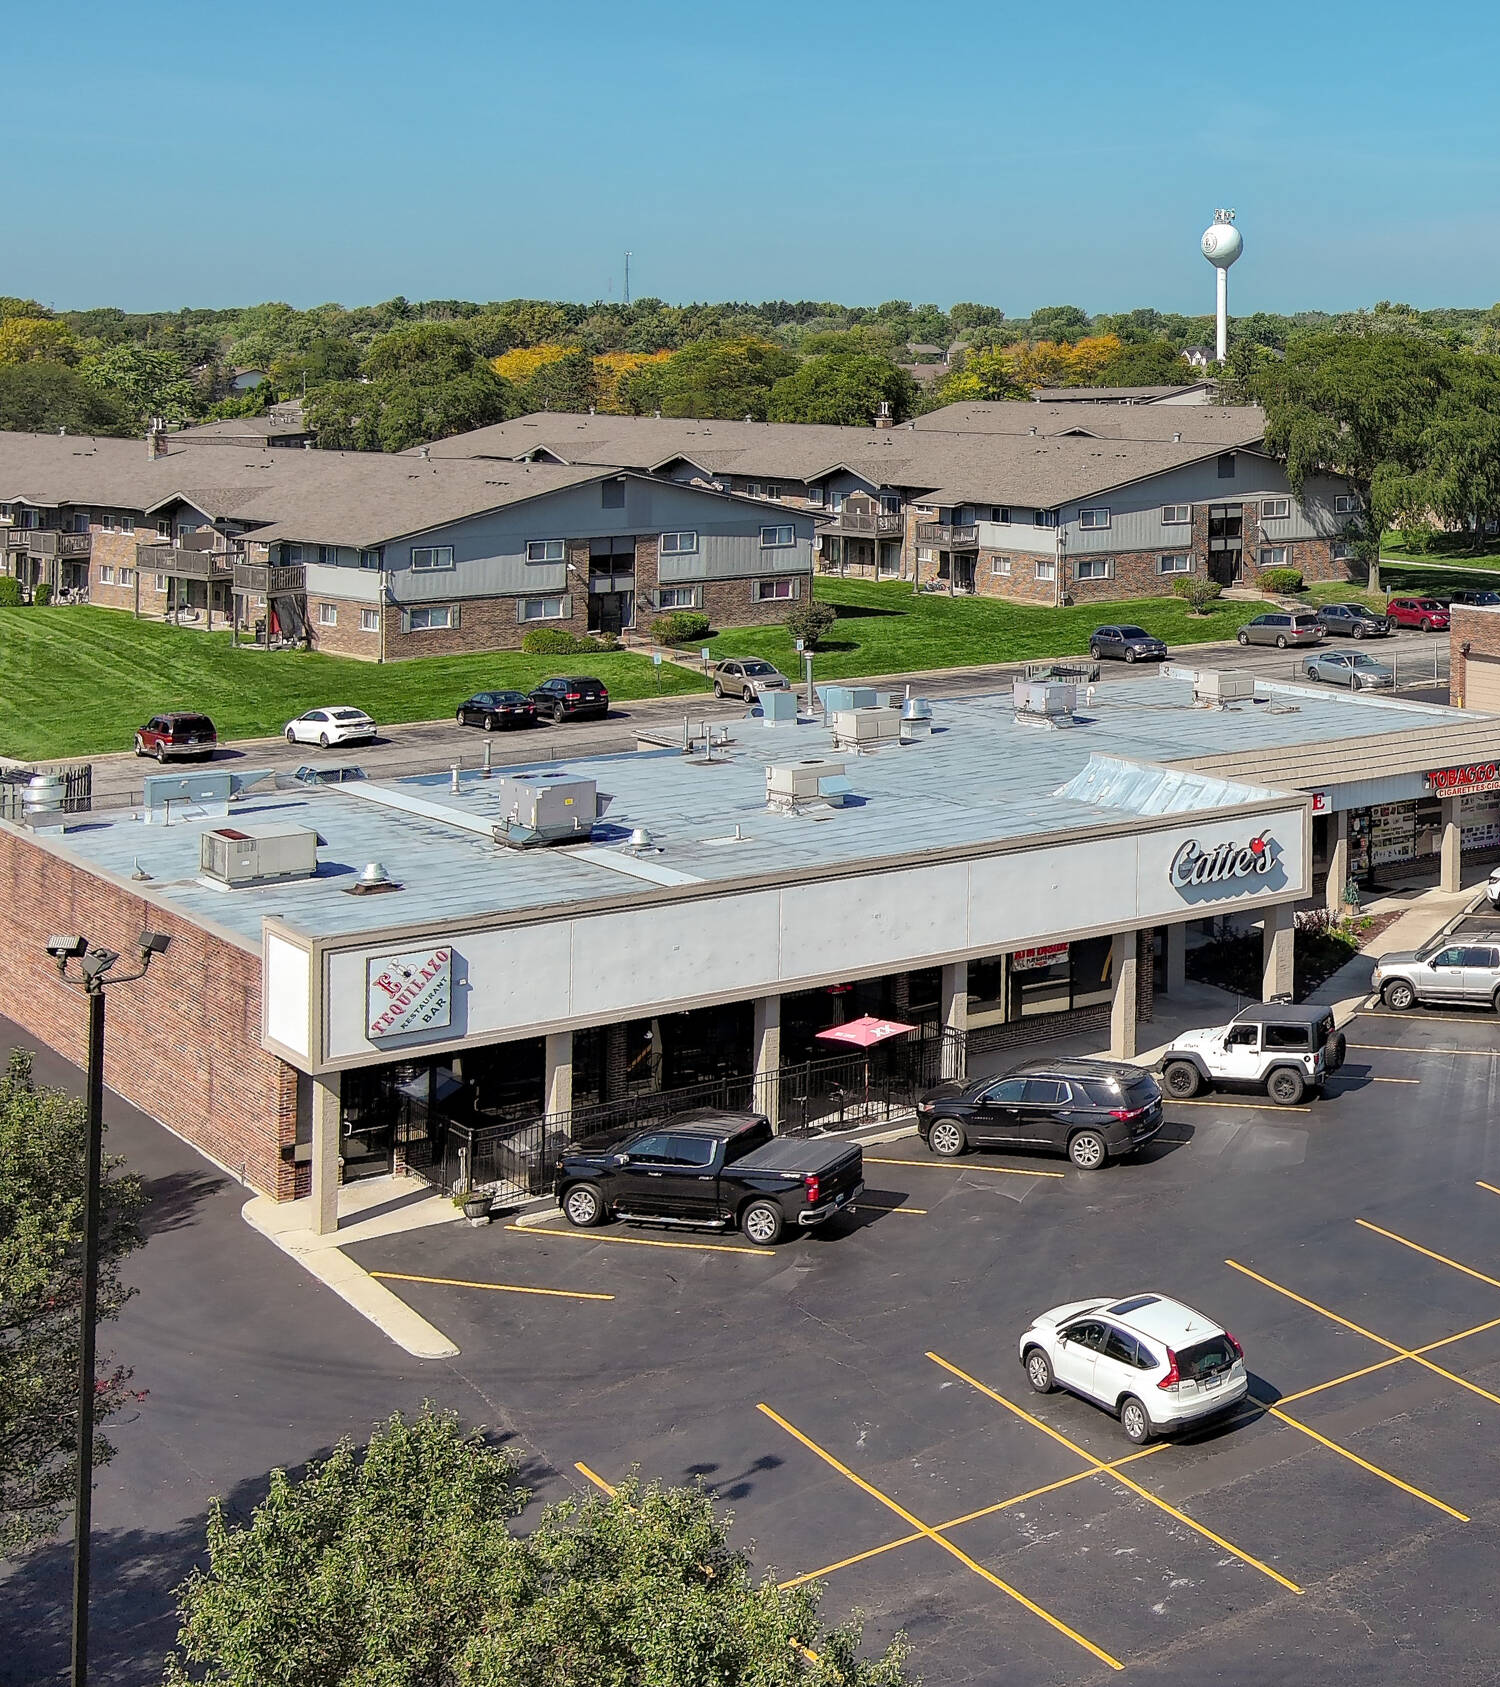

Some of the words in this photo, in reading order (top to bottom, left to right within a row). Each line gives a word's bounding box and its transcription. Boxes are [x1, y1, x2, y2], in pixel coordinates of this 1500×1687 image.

[1427, 763, 1496, 789] TOBACCO
[371, 950, 449, 1035] TEQUILAZO
[400, 976, 447, 1029] RESTAURANT
[422, 998, 446, 1023] BAR
